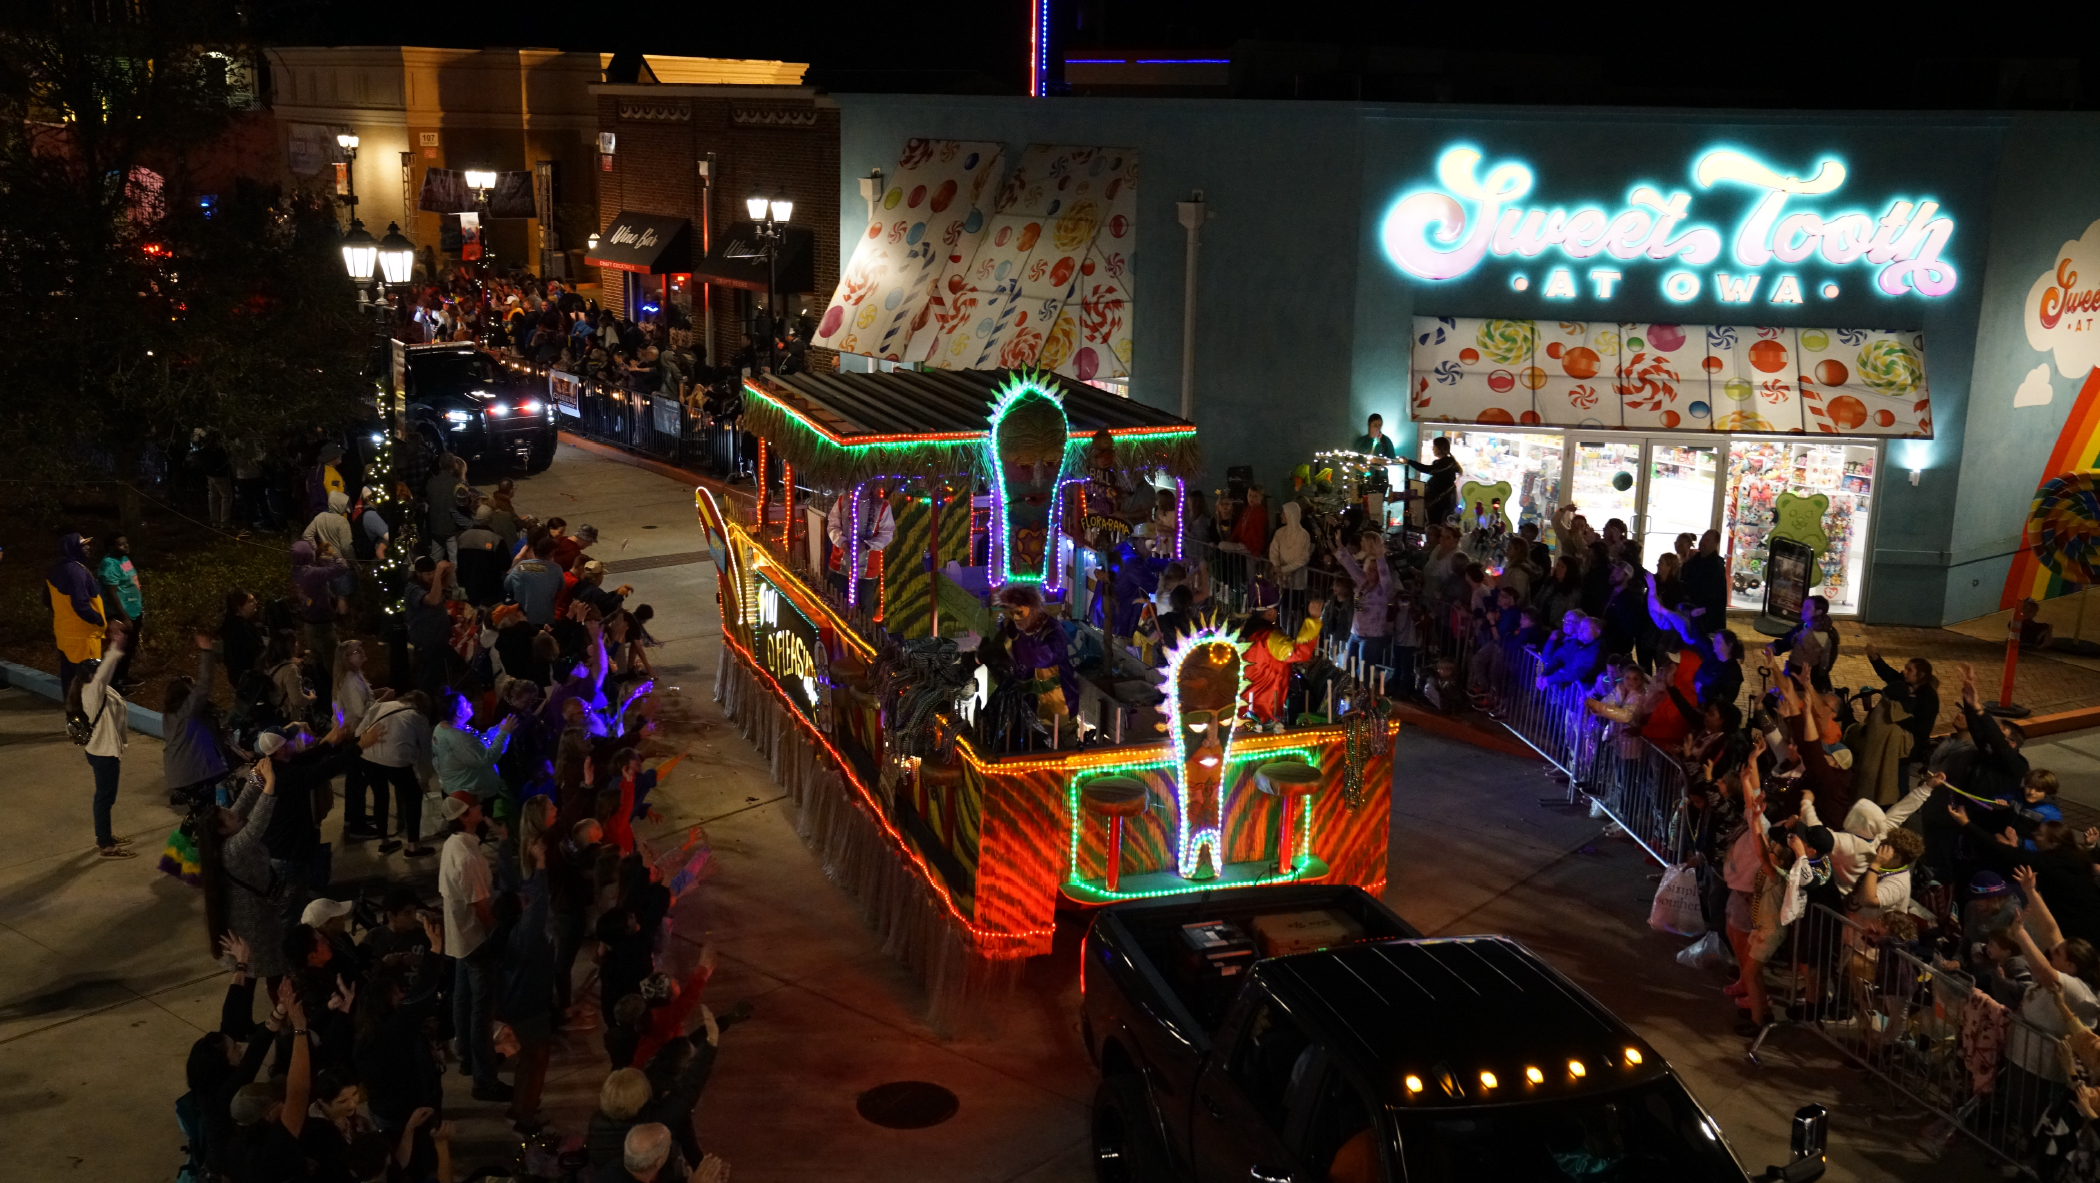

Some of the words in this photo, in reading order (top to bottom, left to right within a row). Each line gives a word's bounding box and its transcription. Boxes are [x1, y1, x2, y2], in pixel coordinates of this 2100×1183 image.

[422, 134, 435, 142] 107
[1383, 148, 1721, 281] Sweet
[1697, 151, 1956, 298] Tooth
[610, 225, 639, 245] Wine
[634, 227, 659, 249] Bar
[599, 260, 613, 268] CRAFT
[612, 262, 635, 271] COCKTAILS
[1546, 270, 1622, 299] AT
[1667, 273, 1804, 304] OWA
[2075, 318, 2093, 332] AT
[1089, 468, 1111, 486] BALL
[1656, 896, 1702, 911] souther
